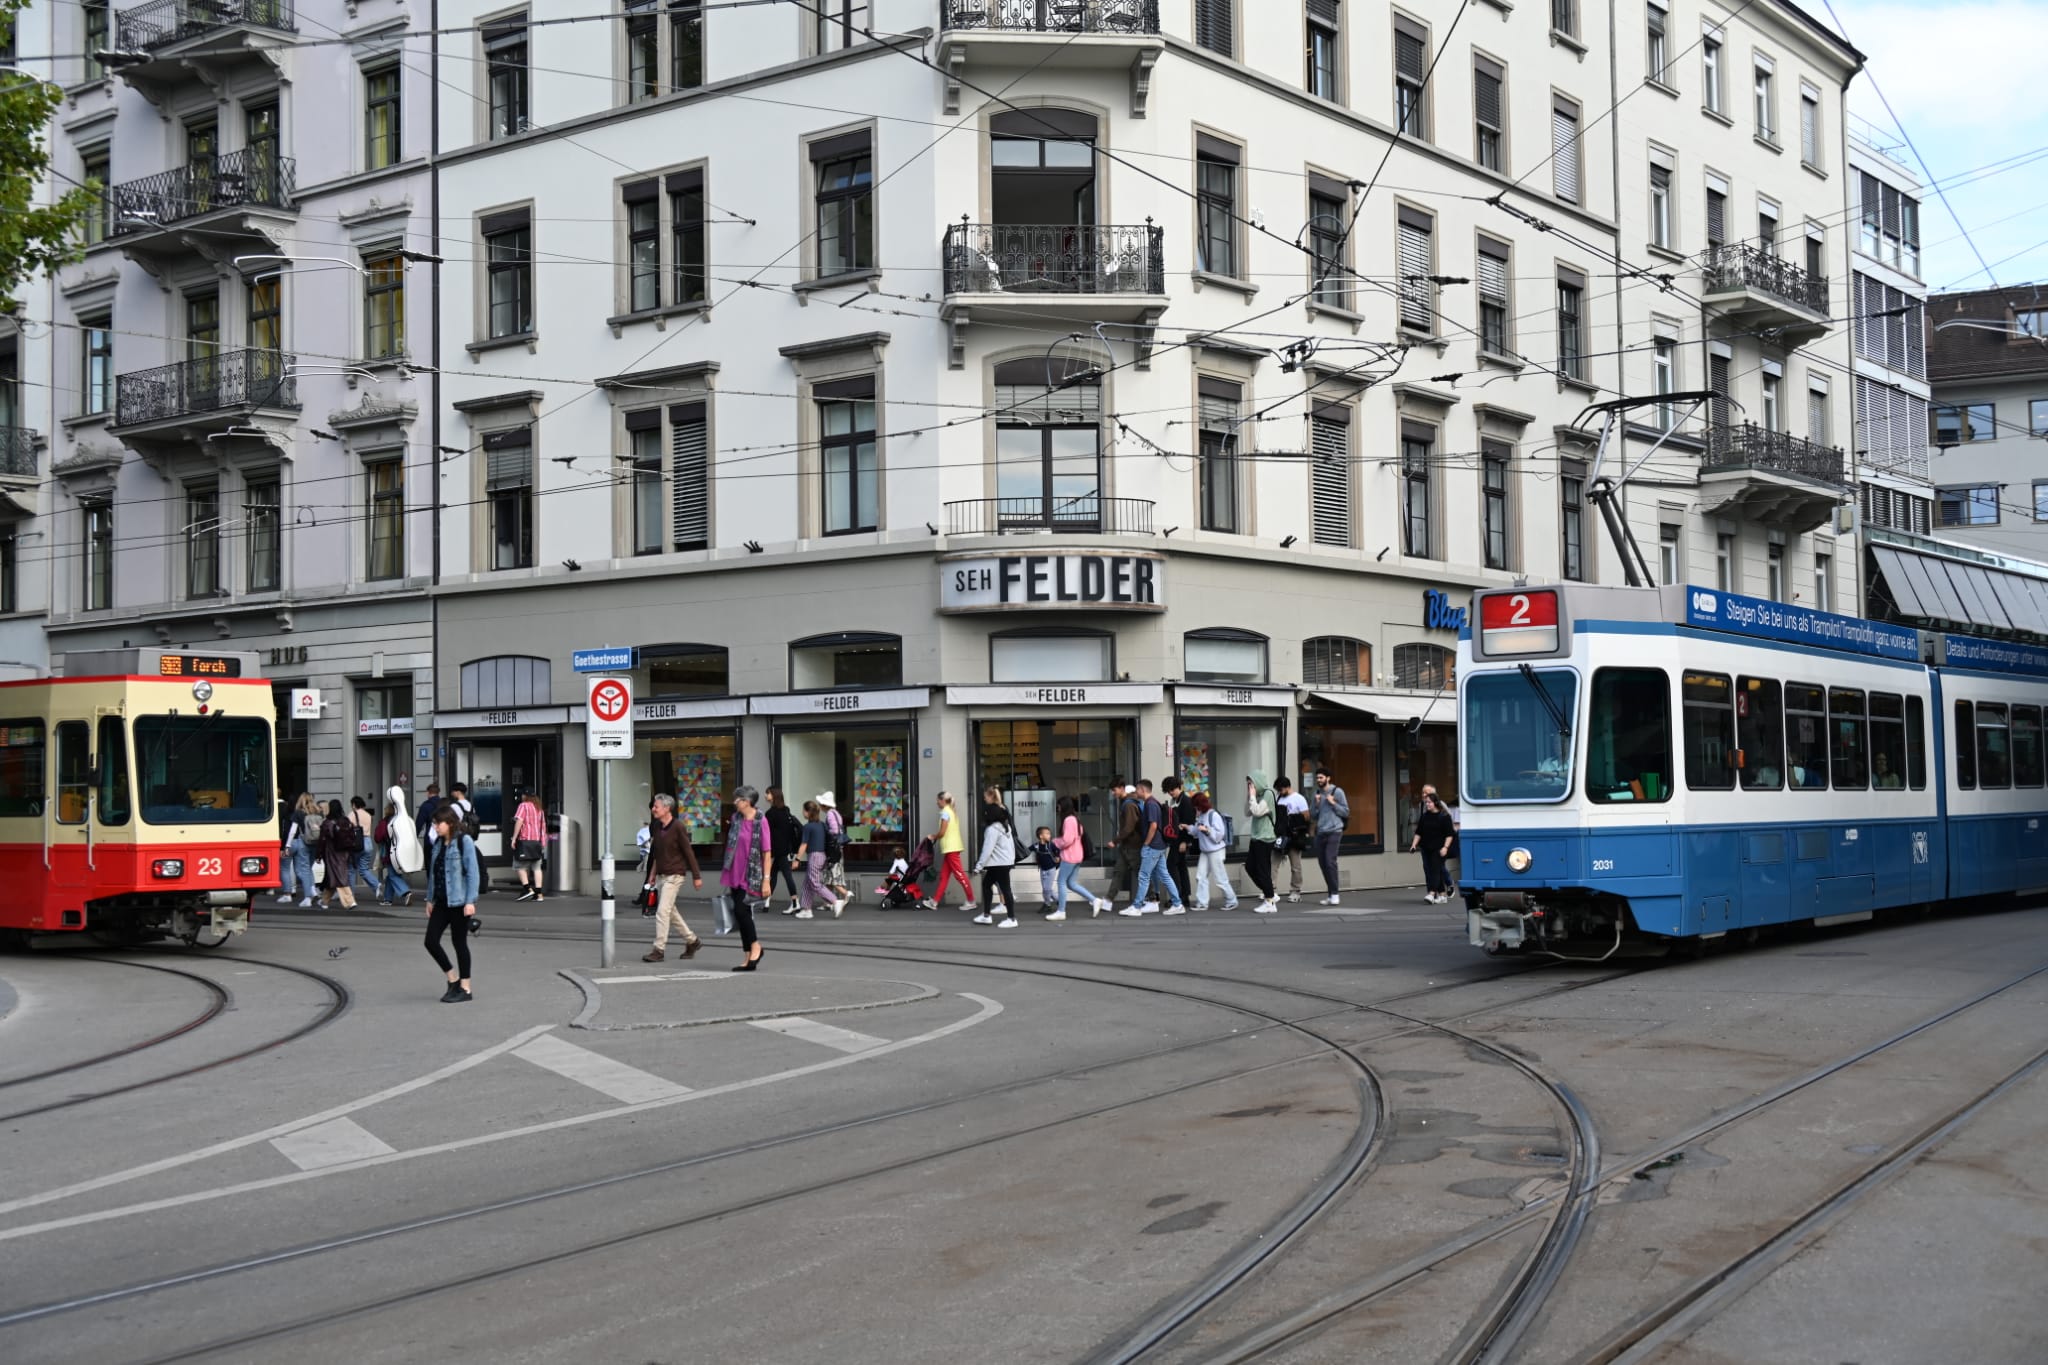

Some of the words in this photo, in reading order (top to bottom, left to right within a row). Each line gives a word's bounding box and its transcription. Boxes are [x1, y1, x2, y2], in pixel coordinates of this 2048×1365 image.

[956, 569, 991, 592] SEH
[999, 556, 1155, 603] FELDER
[1426, 588, 1467, 630] Blue
[1510, 594, 1531, 625] 2
[1727, 599, 1756, 627] Steigen
[1758, 604, 1770, 626] Sie
[1771, 608, 1783, 628] bei
[1784, 614, 1797, 631] uns
[1799, 612, 1809, 633] als
[271, 646, 308, 666] HUG
[1946, 640, 1967, 659] Details
[1967, 645, 1979, 660] und
[193, 659, 227, 674] Forch
[574, 654, 629, 668] Goethestrasse
[824, 695, 859, 710] FELDER
[1038, 688, 1086, 702] FELDER
[1227, 690, 1253, 704] FELDER
[644, 704, 677, 719] FELDER
[1738, 694, 1746, 713] 2
[488, 711, 517, 724] FELDER
[198, 858, 222, 875] 23
[1592, 859, 1614, 871] 2031
